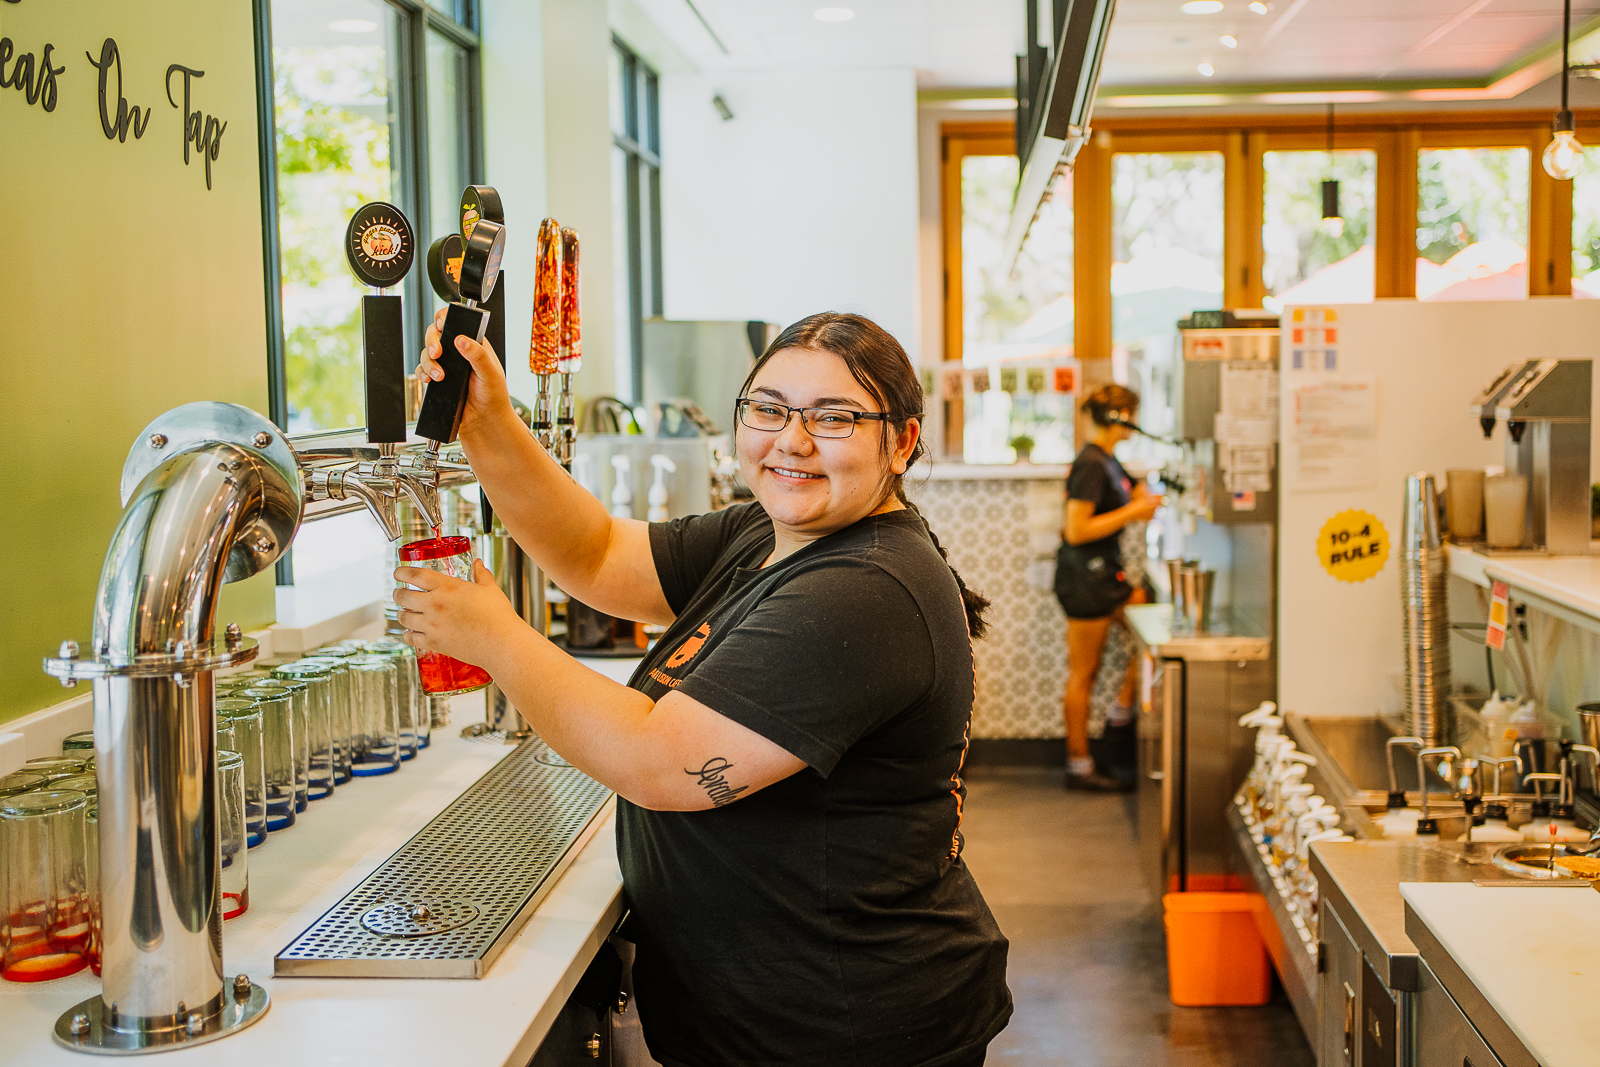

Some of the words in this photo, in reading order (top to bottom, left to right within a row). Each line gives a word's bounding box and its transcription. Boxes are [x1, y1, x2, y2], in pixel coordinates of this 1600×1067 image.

[85, 37, 152, 144] On
[165, 63, 228, 191] Tap
[1331, 524, 1370, 547] 10-4
[1330, 542, 1380, 567] RULE
